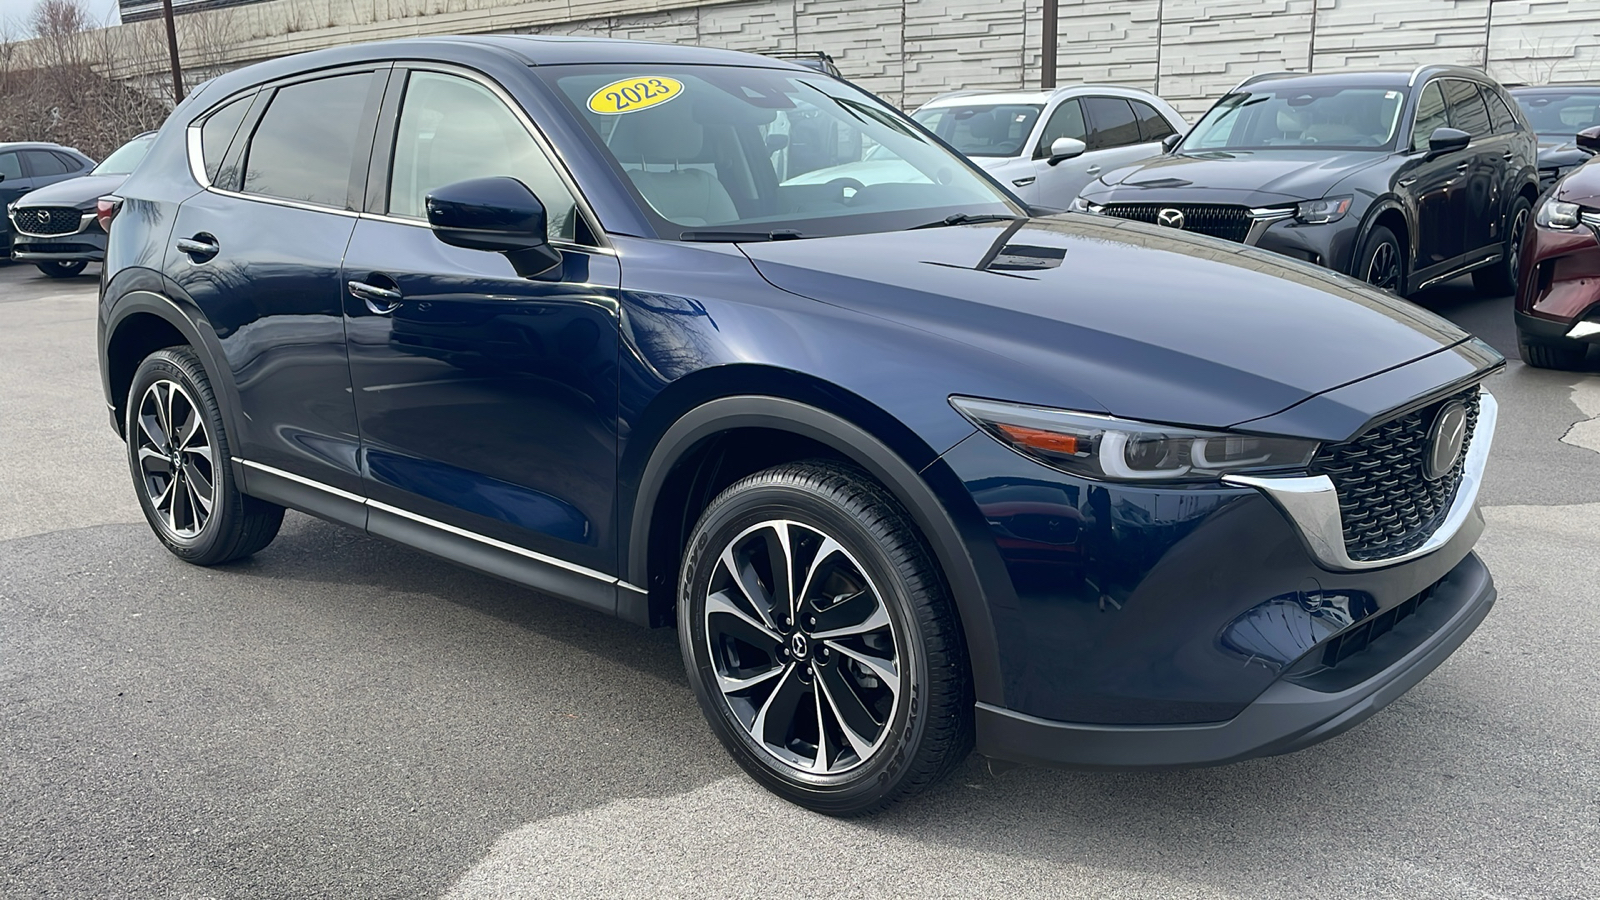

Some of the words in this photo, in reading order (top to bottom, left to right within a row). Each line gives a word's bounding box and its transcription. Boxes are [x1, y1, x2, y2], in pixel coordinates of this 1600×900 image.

[605, 79, 670, 110] 2023
[683, 531, 708, 602] TOYO
[904, 683, 920, 742] TOYO
